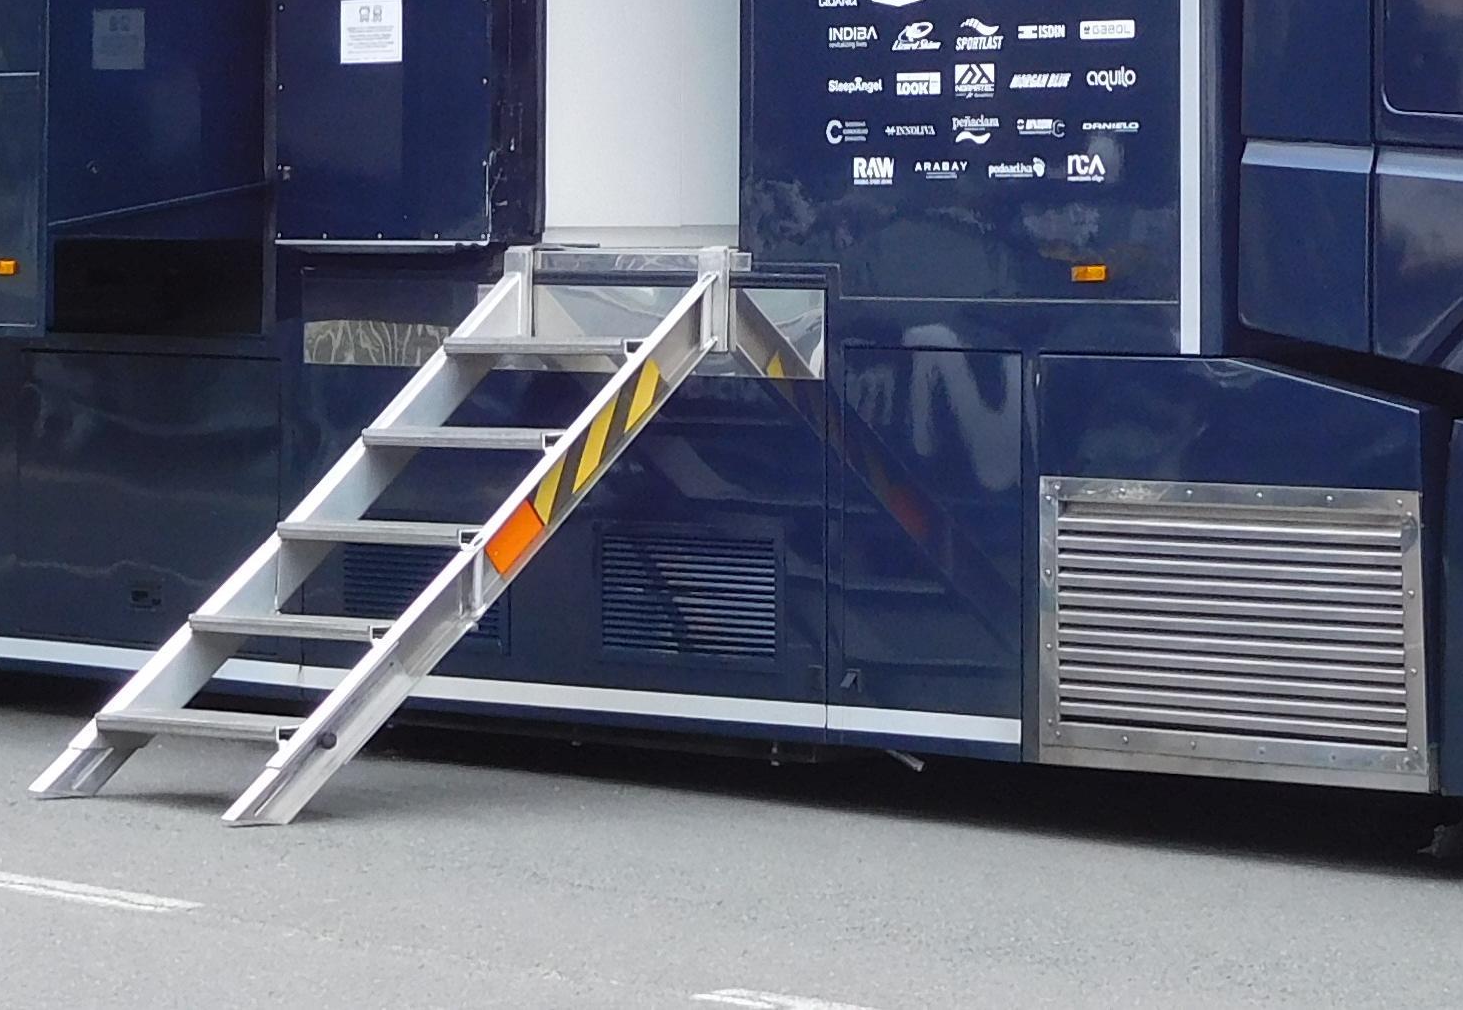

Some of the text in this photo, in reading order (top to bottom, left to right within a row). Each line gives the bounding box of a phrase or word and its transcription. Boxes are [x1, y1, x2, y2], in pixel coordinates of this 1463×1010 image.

[828, 25, 878, 41] INDIBA
[955, 36, 1004, 51] SPORTLAST
[896, 81, 930, 96] LOOK
[853, 157, 895, 178] RAW
[914, 161, 968, 172] ARABAY
